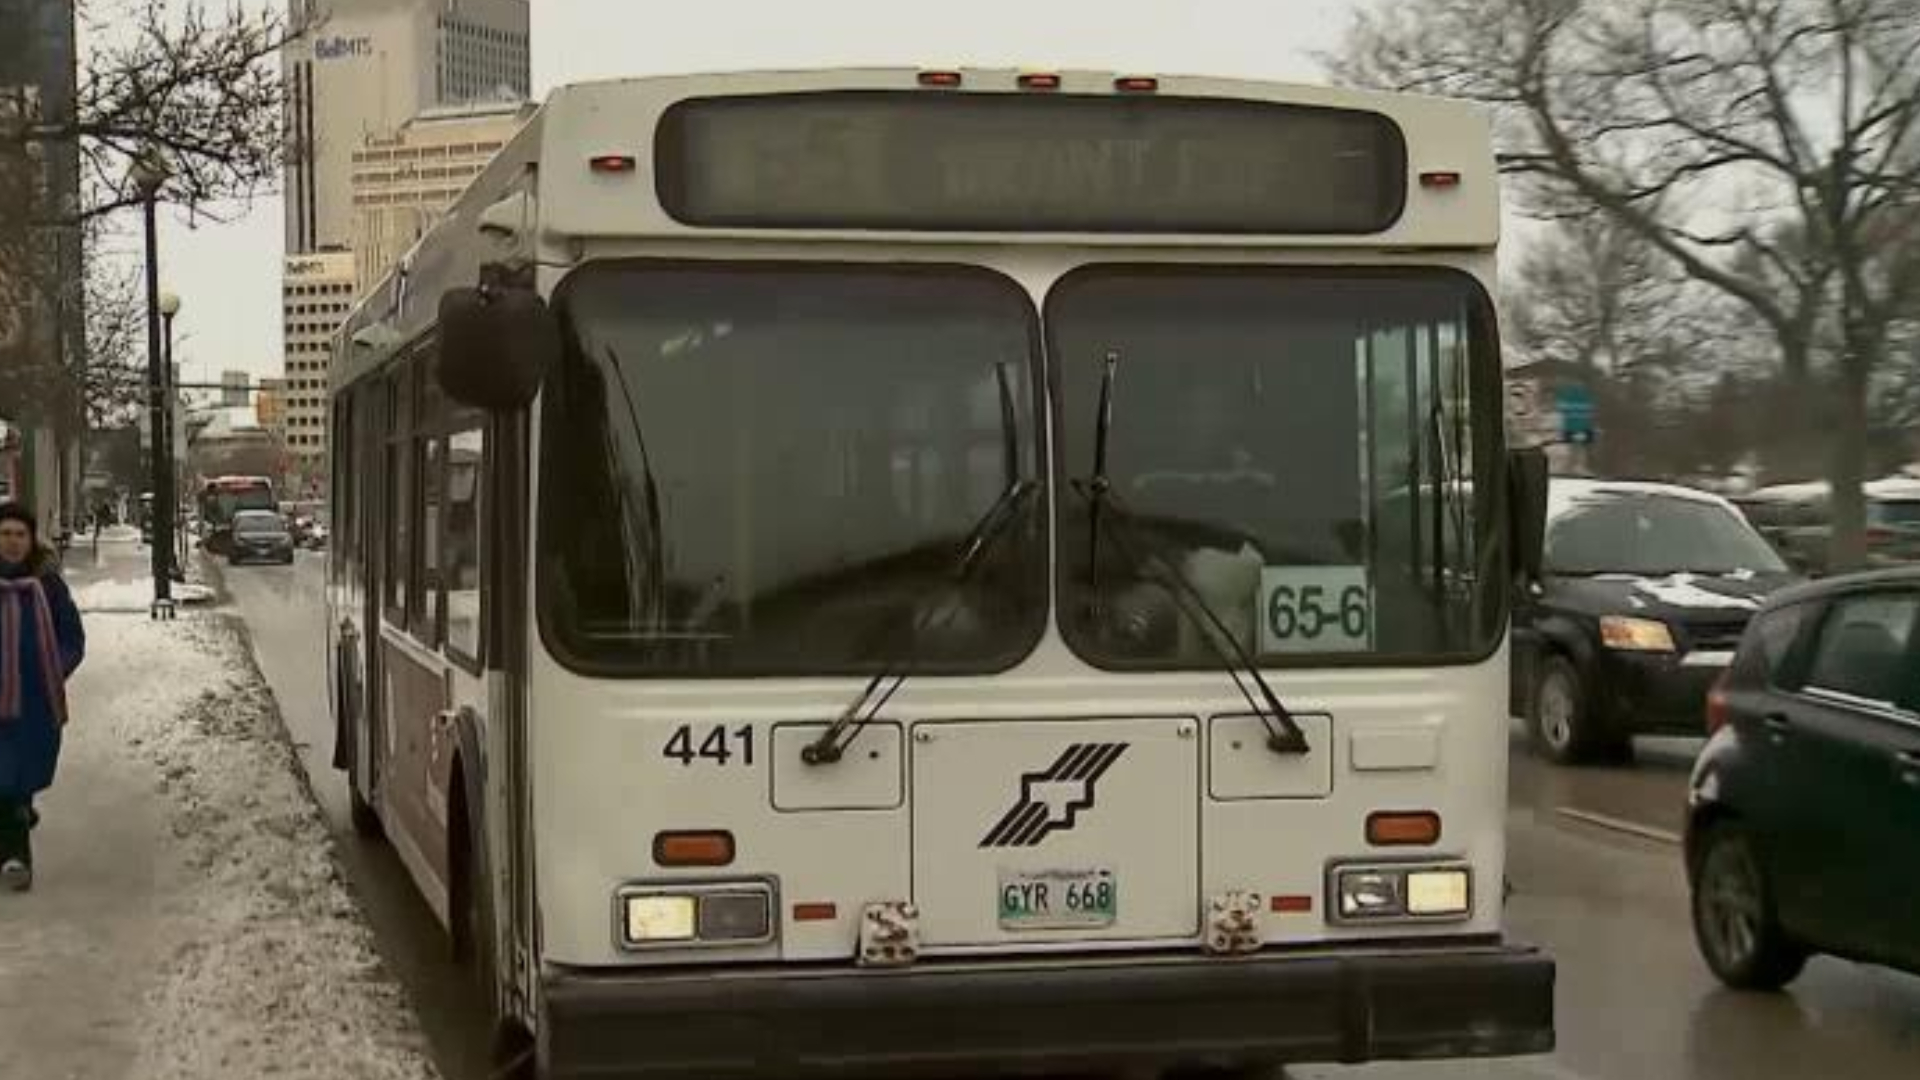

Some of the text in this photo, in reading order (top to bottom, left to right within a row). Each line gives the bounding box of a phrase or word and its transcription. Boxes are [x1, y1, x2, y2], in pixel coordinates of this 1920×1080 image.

[1269, 585, 1366, 639] 65-6
[663, 723, 753, 767] 441
[1004, 882, 1111, 911] GYR 668
